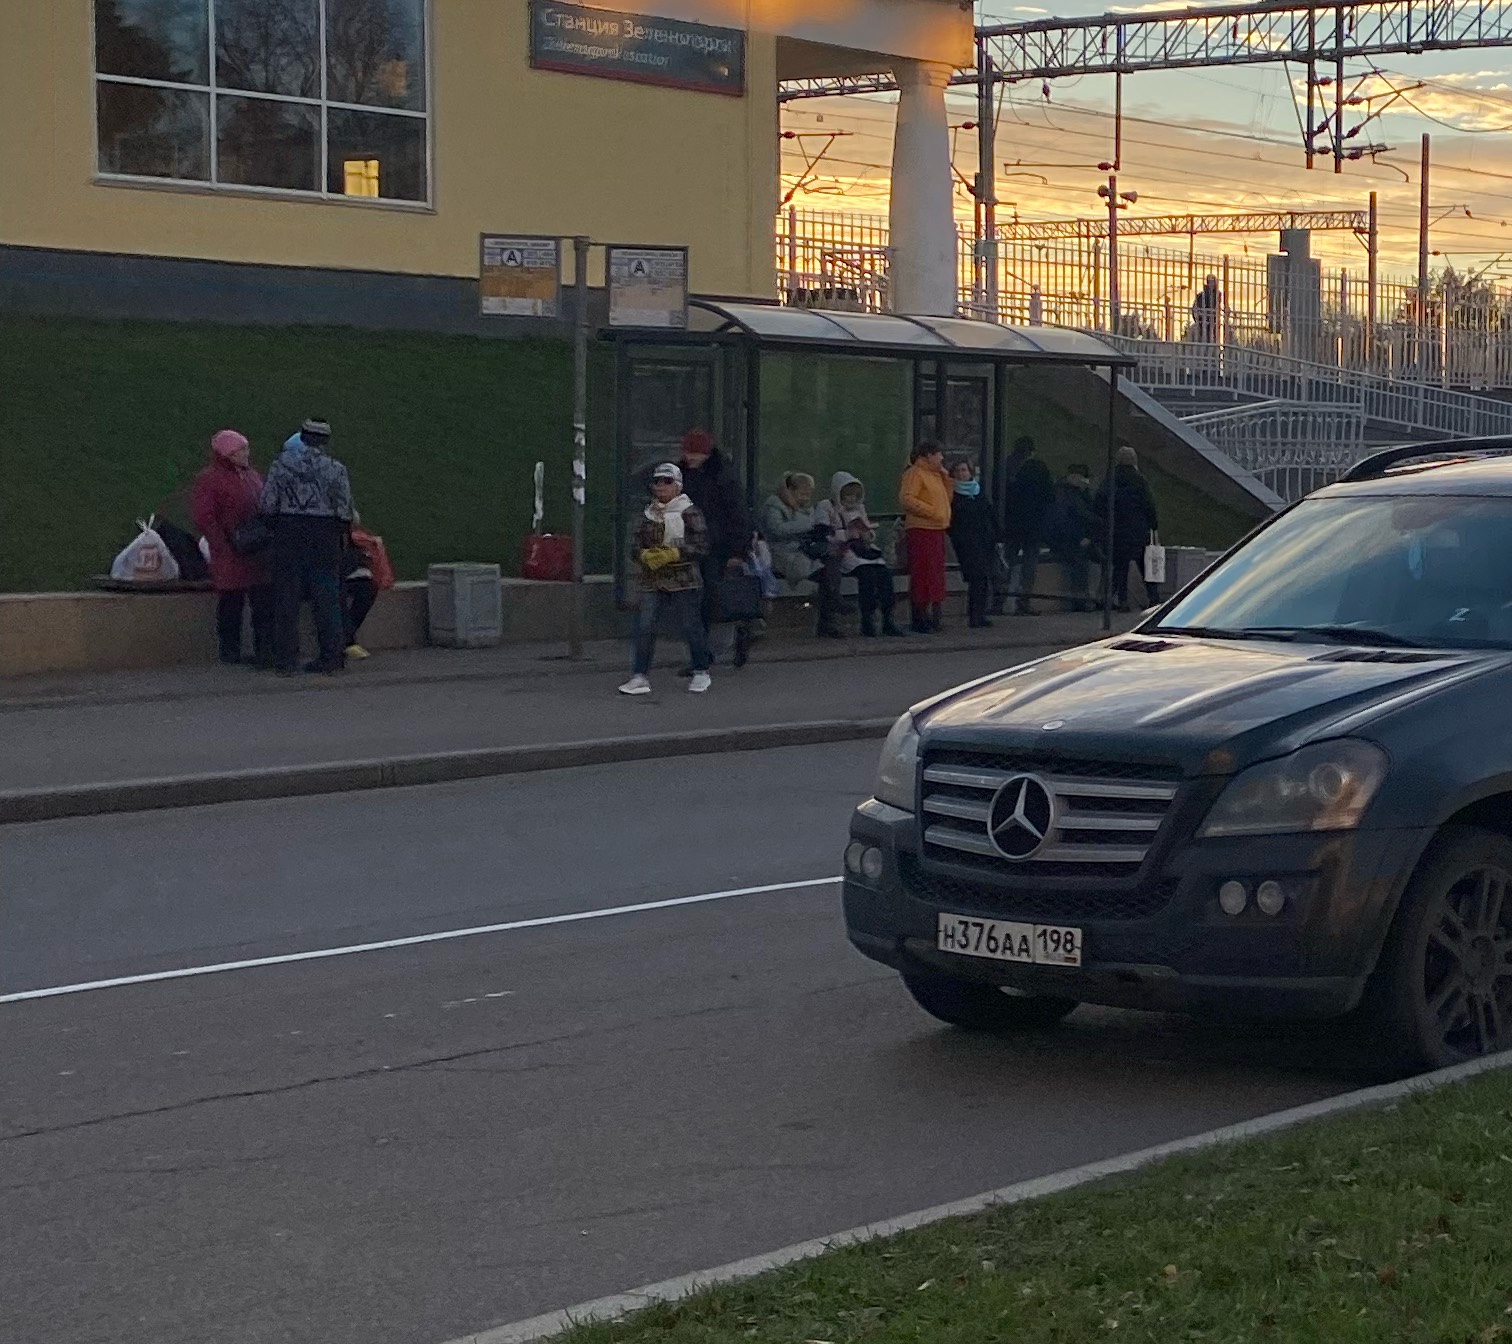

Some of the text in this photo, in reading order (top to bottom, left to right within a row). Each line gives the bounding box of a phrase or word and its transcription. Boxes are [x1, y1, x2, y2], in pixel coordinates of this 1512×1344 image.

[543, 8, 619, 36] Станция
[943, 920, 1075, 957] Н376АА 198
